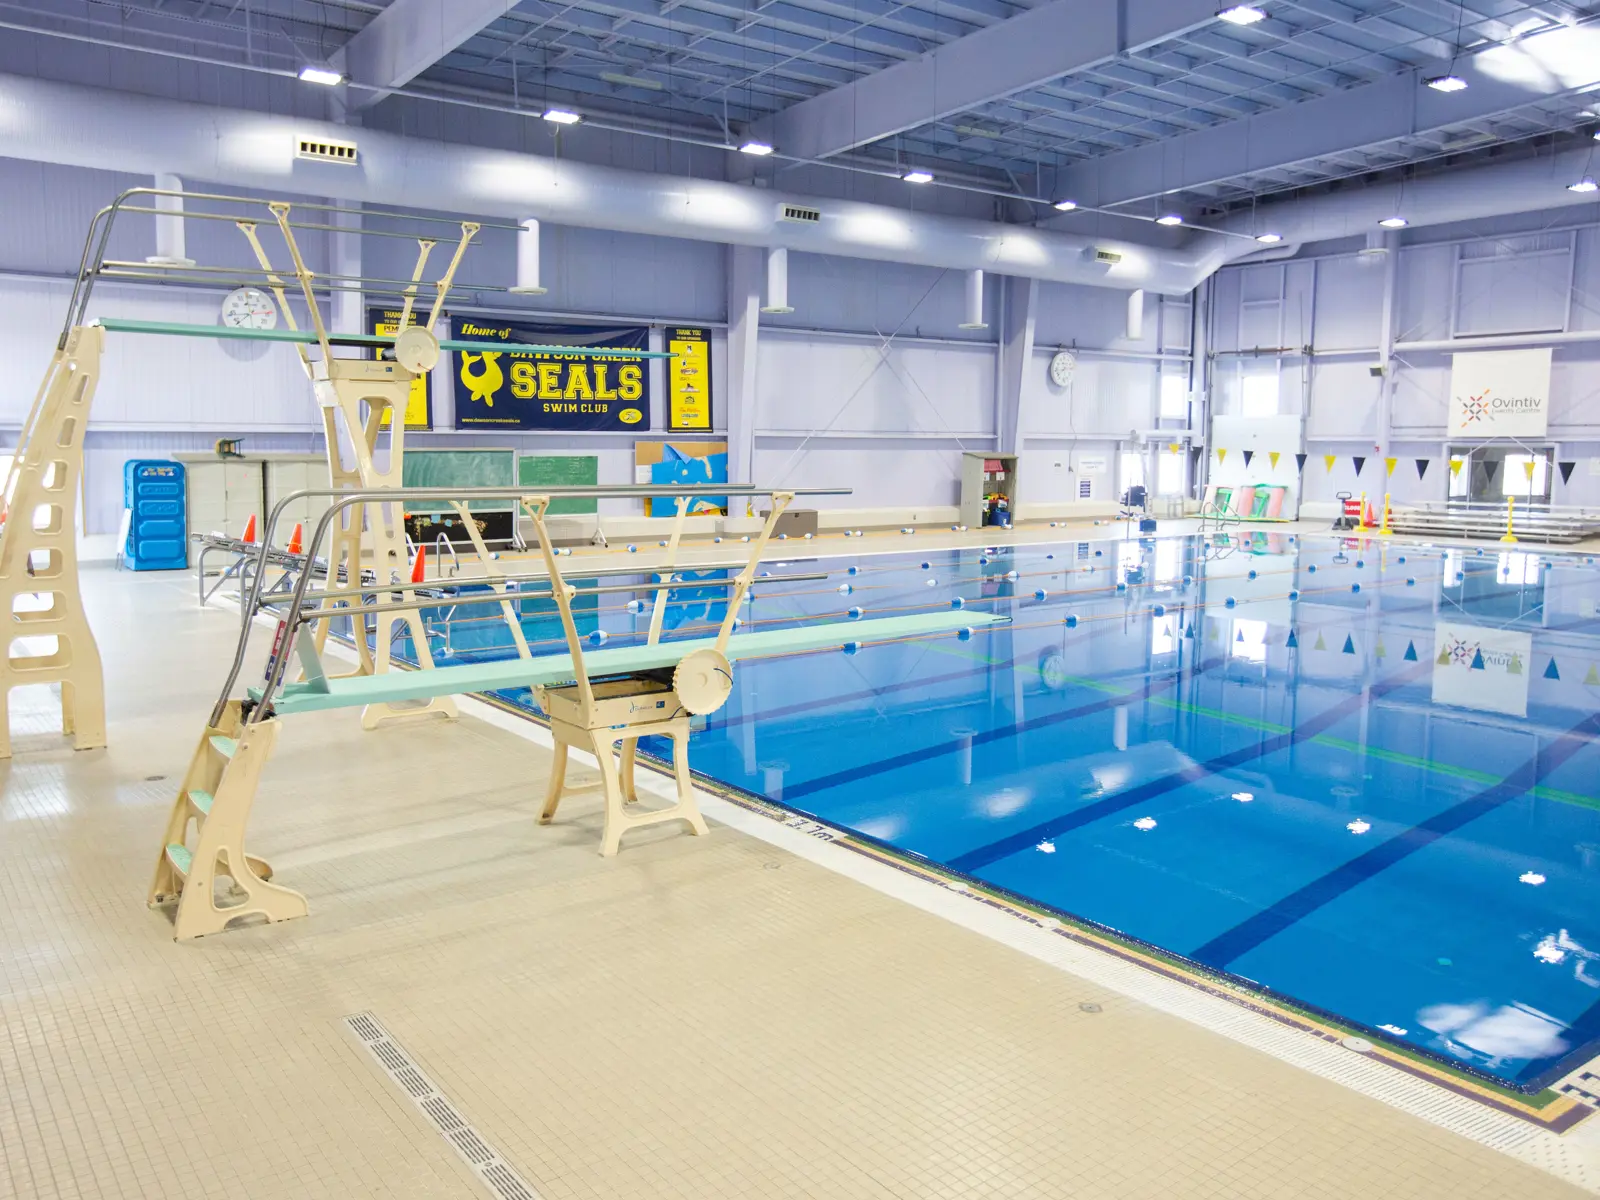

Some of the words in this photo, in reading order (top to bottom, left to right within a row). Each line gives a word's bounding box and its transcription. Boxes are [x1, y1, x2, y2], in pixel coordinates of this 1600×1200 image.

[461, 323, 496, 337] Home
[498, 327, 512, 339] of
[509, 361, 643, 400] SEALS
[543, 403, 578, 413] SWIM
[580, 403, 608, 413] CLUB
[1491, 397, 1541, 408] Ovintiv
